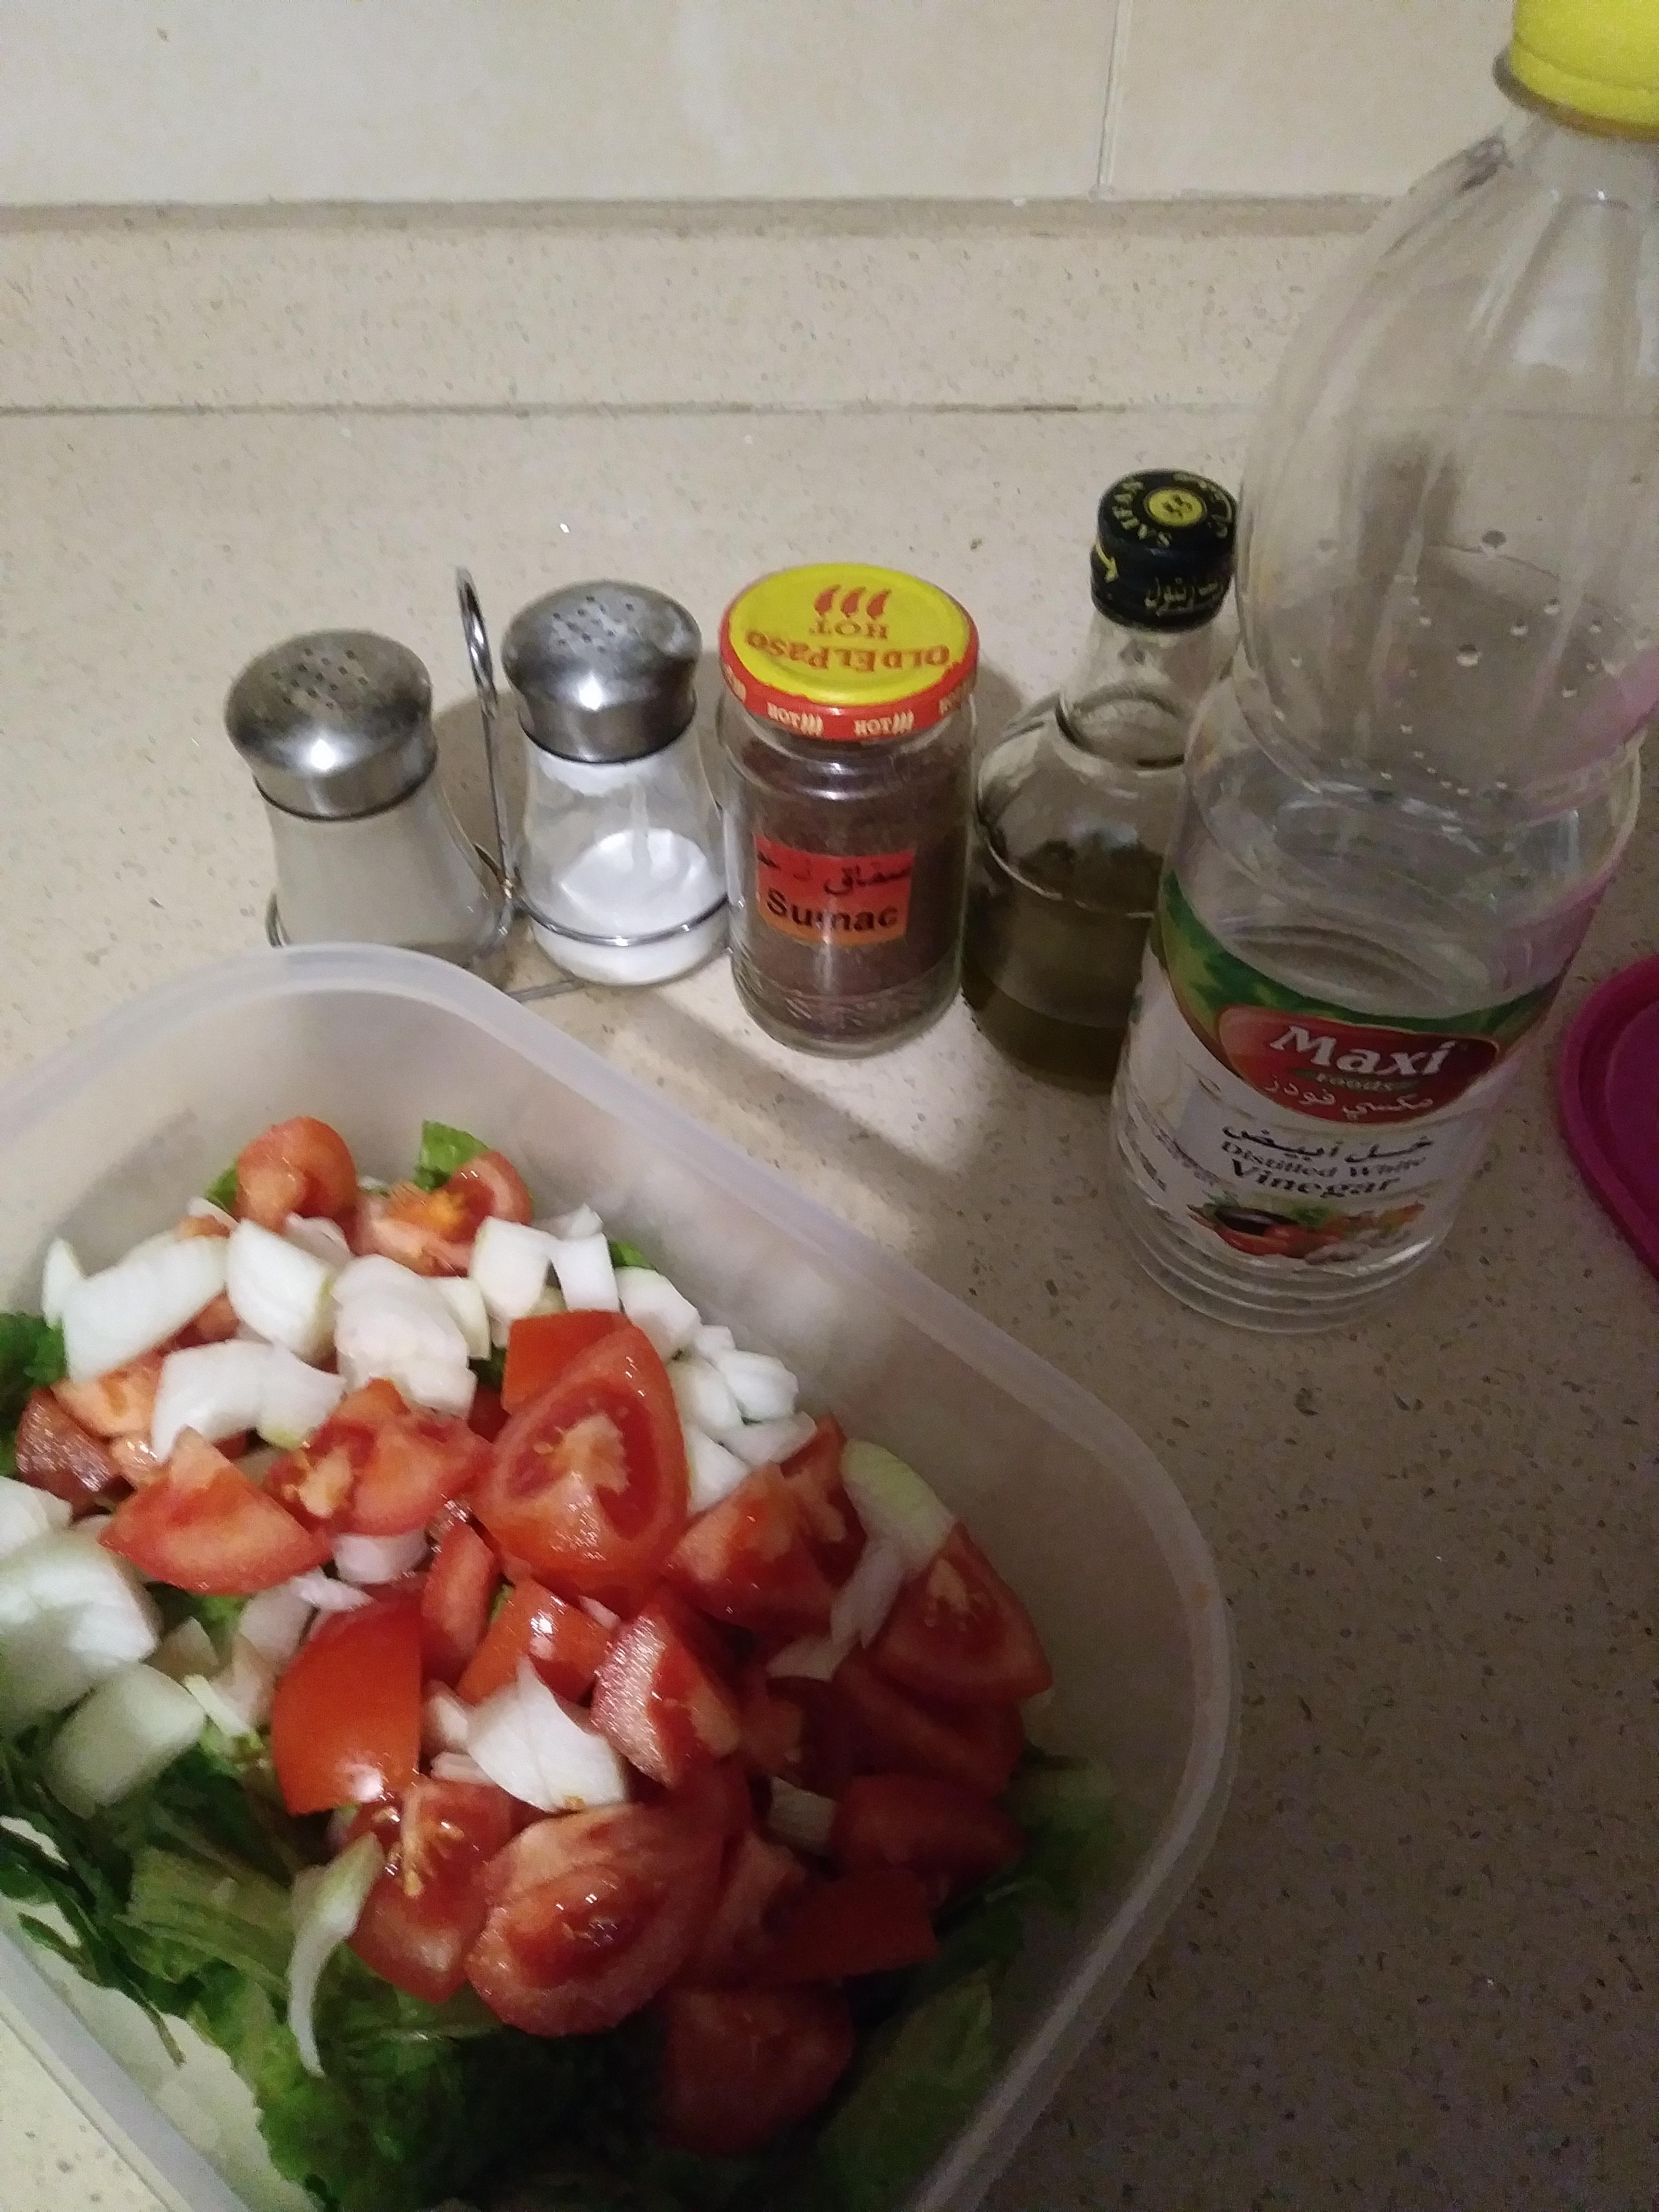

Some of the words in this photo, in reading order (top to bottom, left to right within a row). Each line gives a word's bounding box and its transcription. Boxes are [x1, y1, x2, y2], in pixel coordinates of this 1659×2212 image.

[809, 618, 889, 639] HOT
[766, 887, 899, 932] Sumac
[1269, 1024, 1457, 1076] Maxi
[1231, 1158, 1401, 1198] Vinegar
